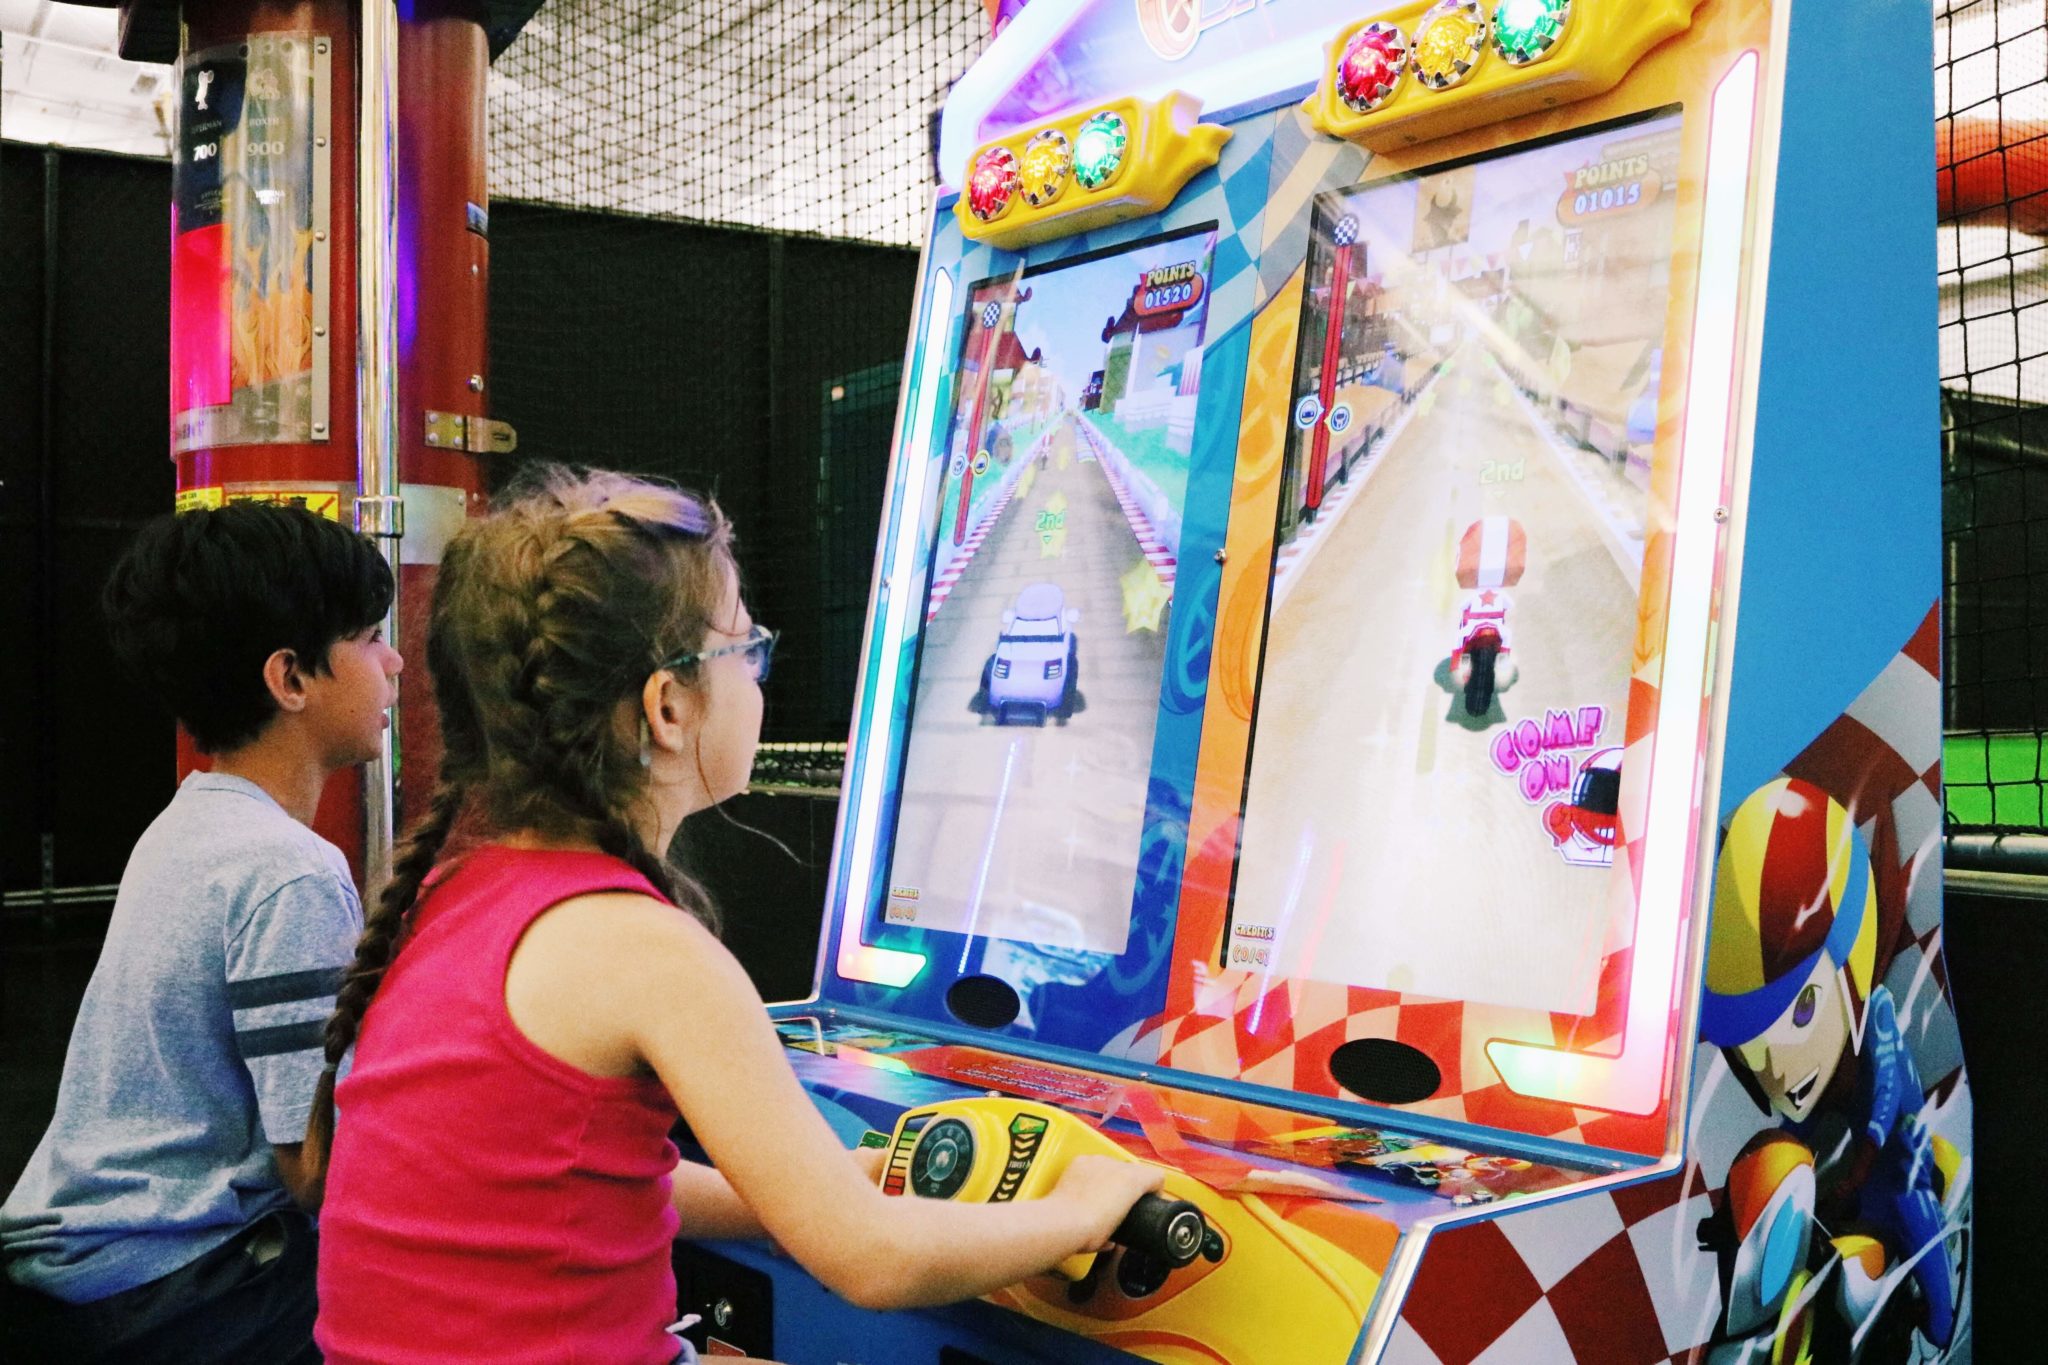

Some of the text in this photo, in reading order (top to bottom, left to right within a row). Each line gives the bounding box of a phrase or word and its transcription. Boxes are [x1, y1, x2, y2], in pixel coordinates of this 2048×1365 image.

[193, 142, 218, 162] 700
[247, 141, 285, 156] 900
[1573, 153, 1649, 190] POINTS
[1573, 181, 1641, 216] 01015
[1144, 260, 1197, 288] POINTS
[1144, 282, 1192, 310] 01520
[1478, 456, 1528, 485] 2nd
[1034, 509, 1065, 532] 2nd
[1490, 703, 1604, 774] COME
[1519, 755, 1571, 801] ON
